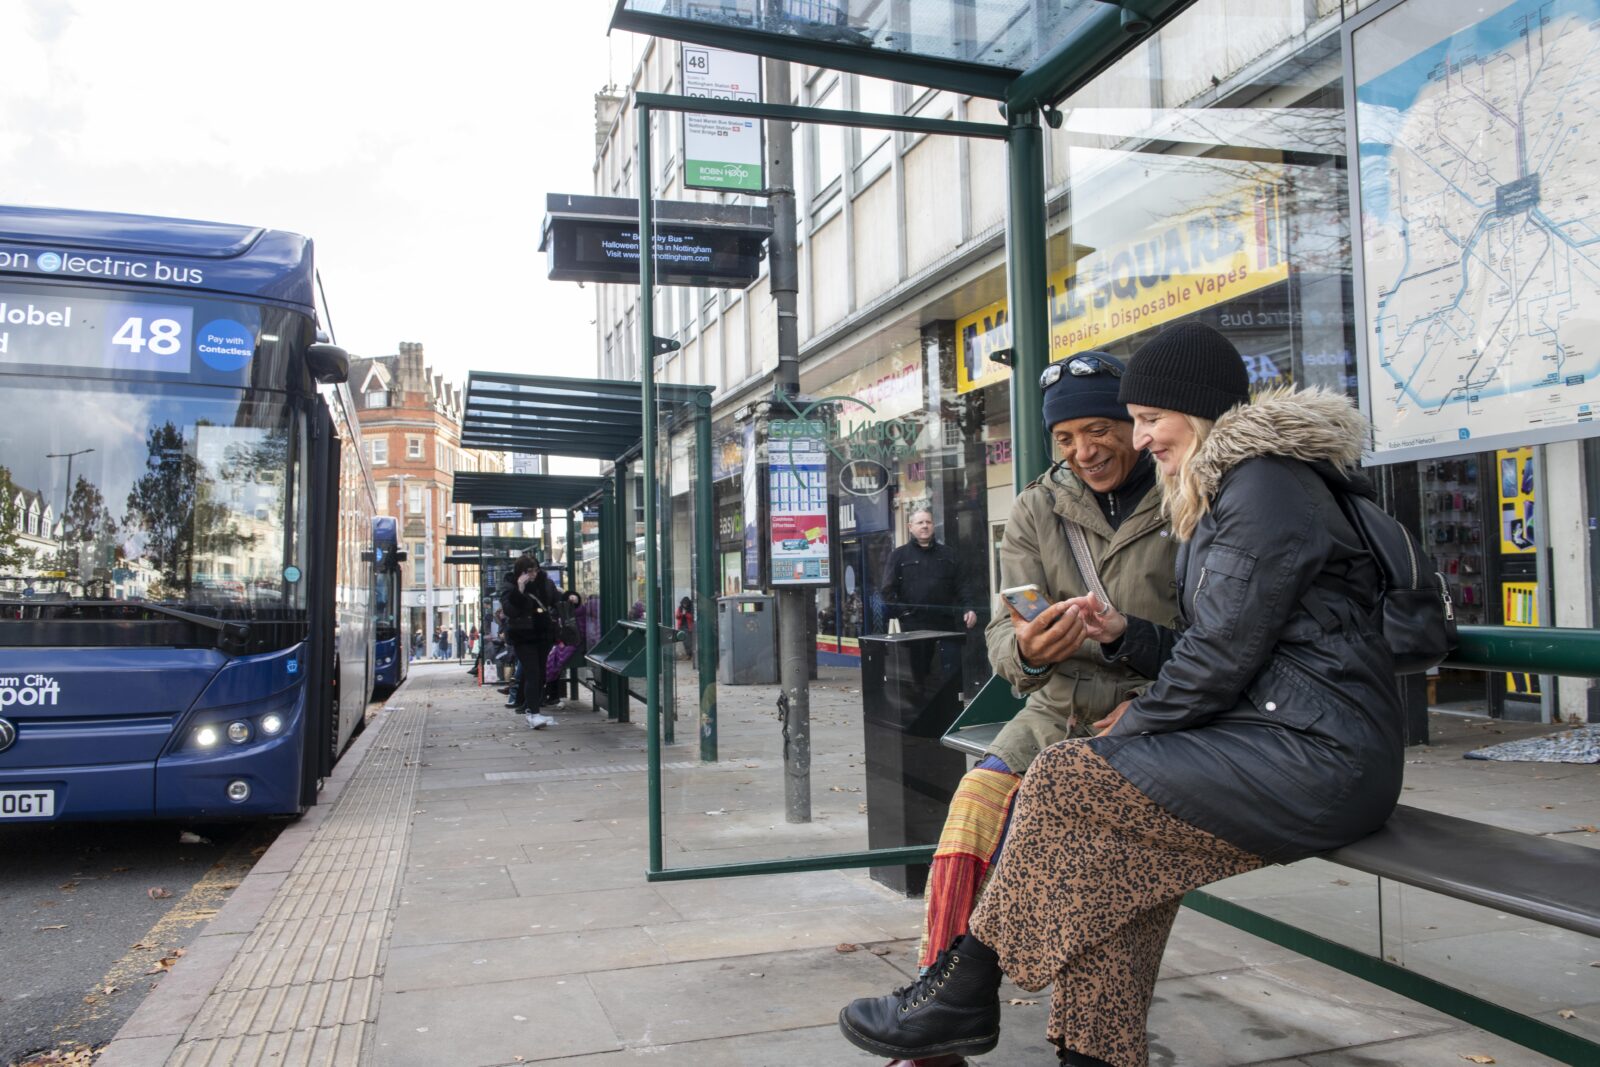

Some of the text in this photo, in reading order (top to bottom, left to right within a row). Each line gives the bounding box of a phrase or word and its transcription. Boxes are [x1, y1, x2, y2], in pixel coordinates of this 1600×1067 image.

[688, 56, 706, 69] 48
[699, 166, 723, 176] ROBIN
[657, 235, 666, 243] by
[668, 235, 682, 243] Bus
[602, 241, 639, 249] Halloween
[673, 245, 712, 254] Nottingham
[37, 252, 147, 278] electric
[155, 261, 203, 284] bus
[1054, 264, 1248, 350] Repairs Disposable Vapes
[112, 317, 181, 355] 48
[207, 334, 244, 345] Pay with
[198, 344, 252, 356] Contactless
[24, 674, 54, 687] City
[2, 793, 48, 814] OGT
